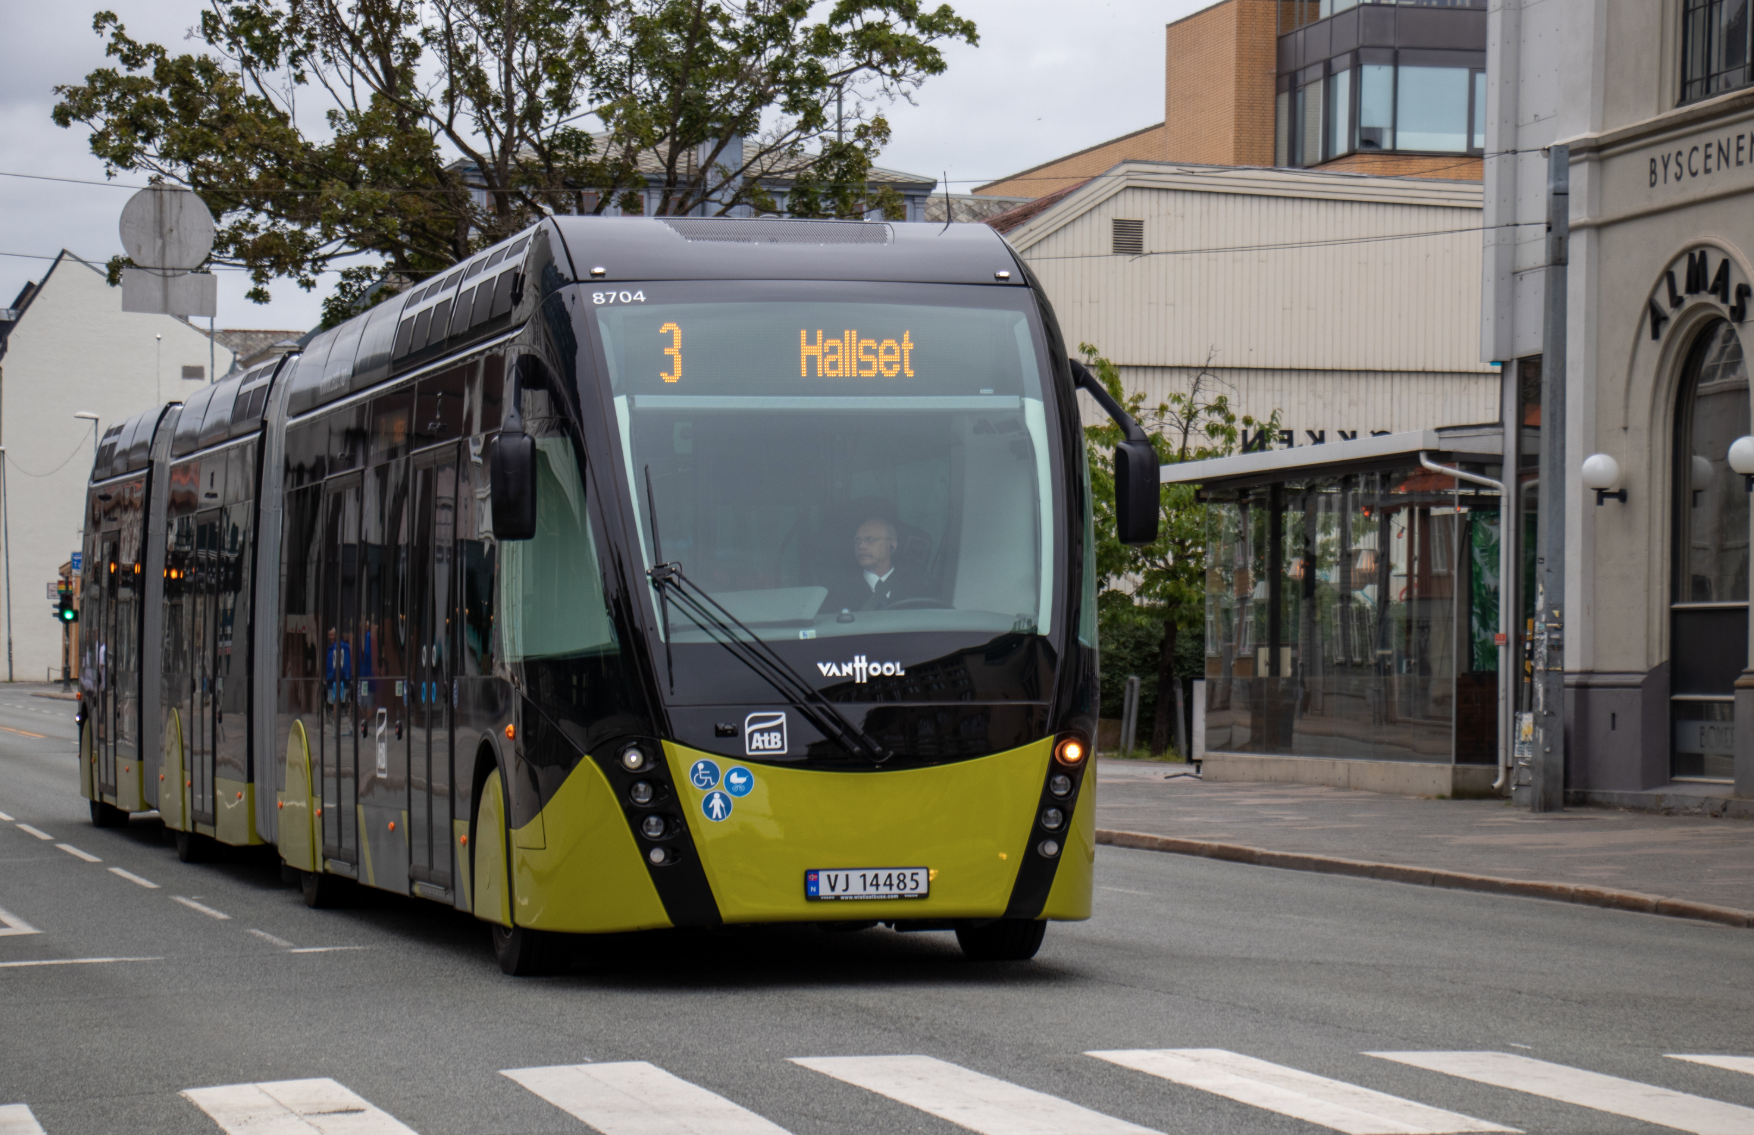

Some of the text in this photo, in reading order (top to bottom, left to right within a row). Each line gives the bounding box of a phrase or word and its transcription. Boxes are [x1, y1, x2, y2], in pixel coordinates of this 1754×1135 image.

[592, 290, 646, 305] 8704
[1650, 250, 1752, 340] ALMAS
[659, 322, 914, 383] 3 Hallset
[751, 732, 782, 750] AtB
[826, 872, 920, 893] VJ 14485
